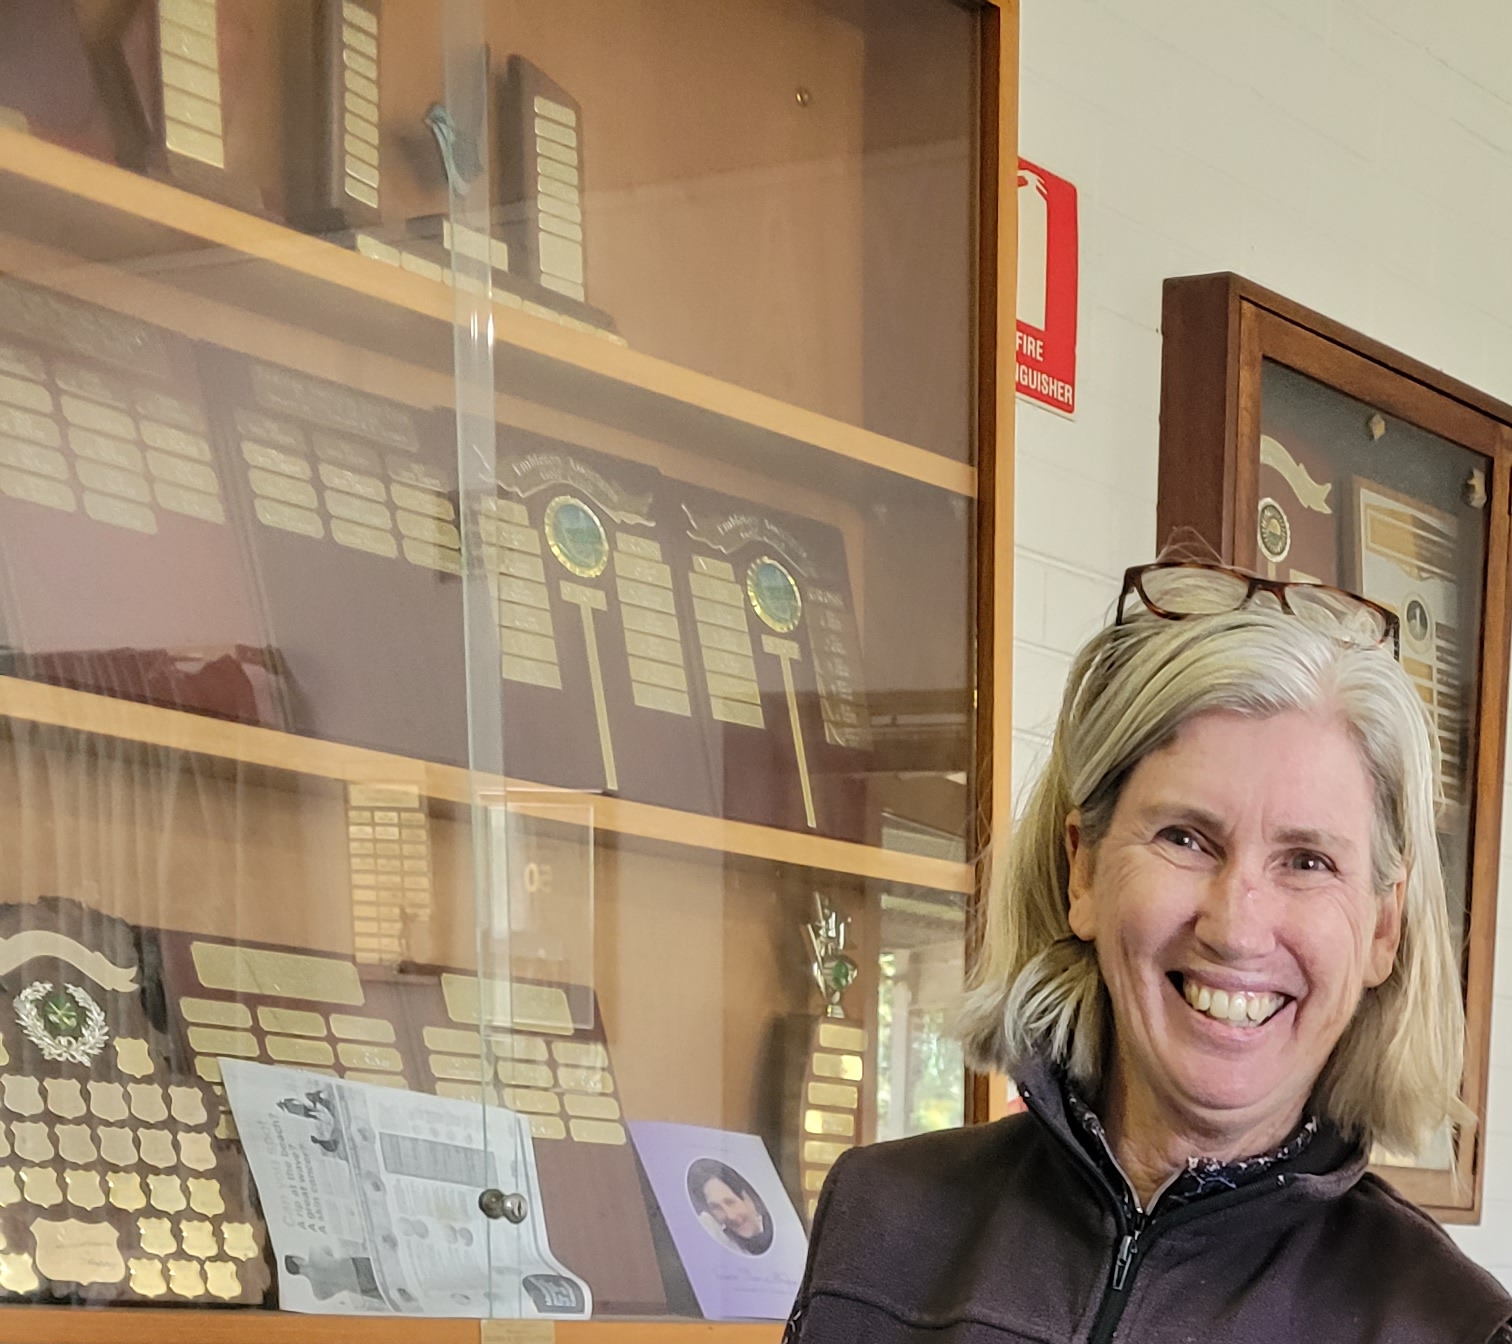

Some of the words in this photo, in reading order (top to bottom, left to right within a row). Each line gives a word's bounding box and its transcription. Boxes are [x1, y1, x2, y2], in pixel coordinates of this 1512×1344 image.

[1016, 330, 1043, 361] FIRE
[268, 1112, 289, 1158] beach?
[284, 1161, 297, 1181] the
[288, 1143, 308, 1183] wave?
[299, 1144, 319, 1194] cancer?
[300, 1187, 315, 1219] great
[298, 1221, 307, 1230] A
[308, 1223, 318, 1233] A
